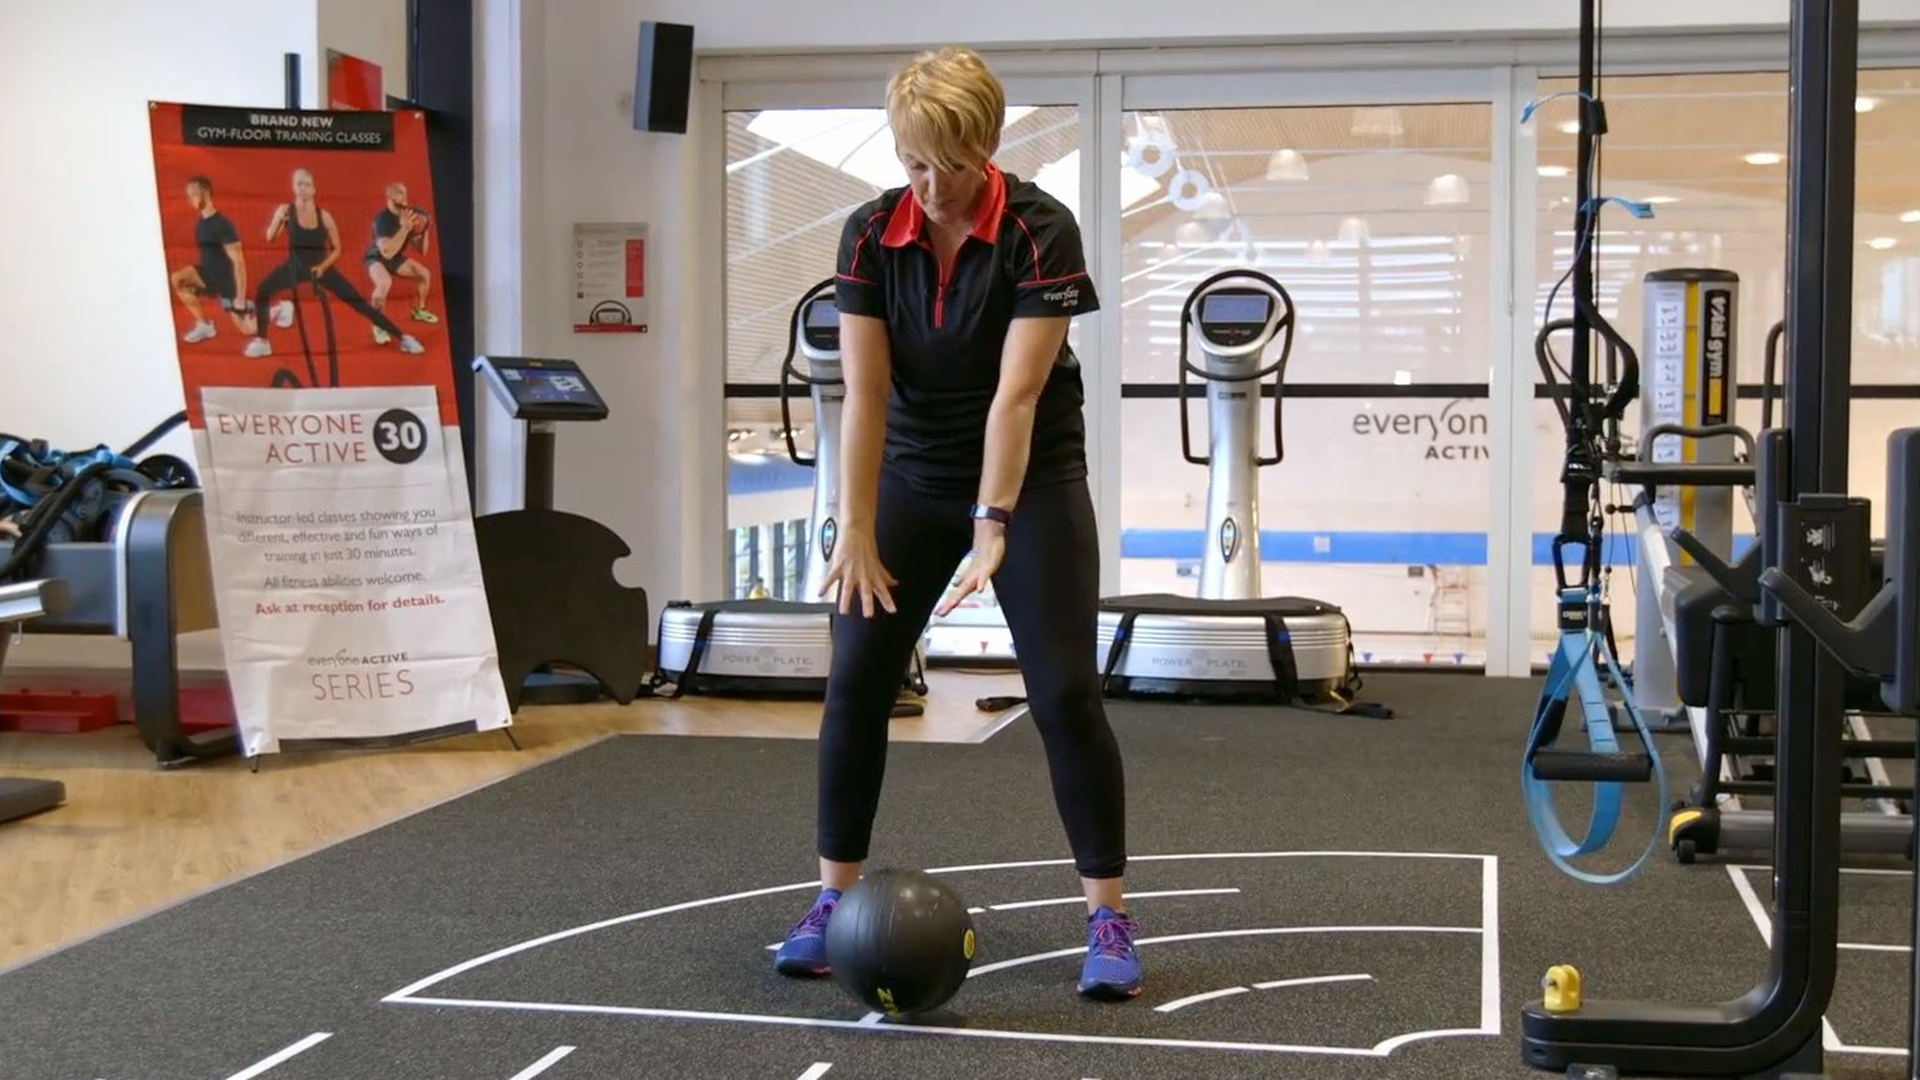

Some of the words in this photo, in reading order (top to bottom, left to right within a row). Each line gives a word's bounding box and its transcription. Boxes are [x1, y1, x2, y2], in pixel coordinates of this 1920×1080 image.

[250, 113, 299, 127] BRAND
[301, 114, 334, 128] NEW
[197, 126, 272, 140] GYM-FLOOR
[275, 129, 333, 143] TRAINING
[335, 131, 382, 144] CLASSES
[1706, 338, 1723, 377] gym
[218, 413, 364, 436] EVERYONE
[1353, 398, 1488, 441] everyon
[379, 421, 422, 451] 30
[266, 441, 368, 464] ACTIVE
[317, 510, 359, 524] classes
[360, 507, 409, 523] showing
[412, 508, 436, 523] you
[292, 530, 341, 544] effective
[344, 529, 366, 542] and
[369, 528, 389, 541] fun
[391, 528, 422, 541] ways
[425, 524, 438, 537] of
[264, 551, 309, 565] training
[311, 549, 322, 562] in
[324, 549, 343, 564] just
[346, 548, 361, 561] 30
[364, 546, 417, 560] minutes.
[263, 576, 280, 589] All
[282, 575, 319, 589] fitness
[322, 575, 363, 588] abilities
[366, 573, 426, 587] welcome.
[255, 602, 281, 616] Ask
[285, 602, 300, 614] at
[303, 600, 364, 616] reception
[368, 598, 388, 612] for
[392, 593, 446, 610] details.
[361, 652, 408, 665] ACTIVE
[311, 669, 414, 701] SERIES
